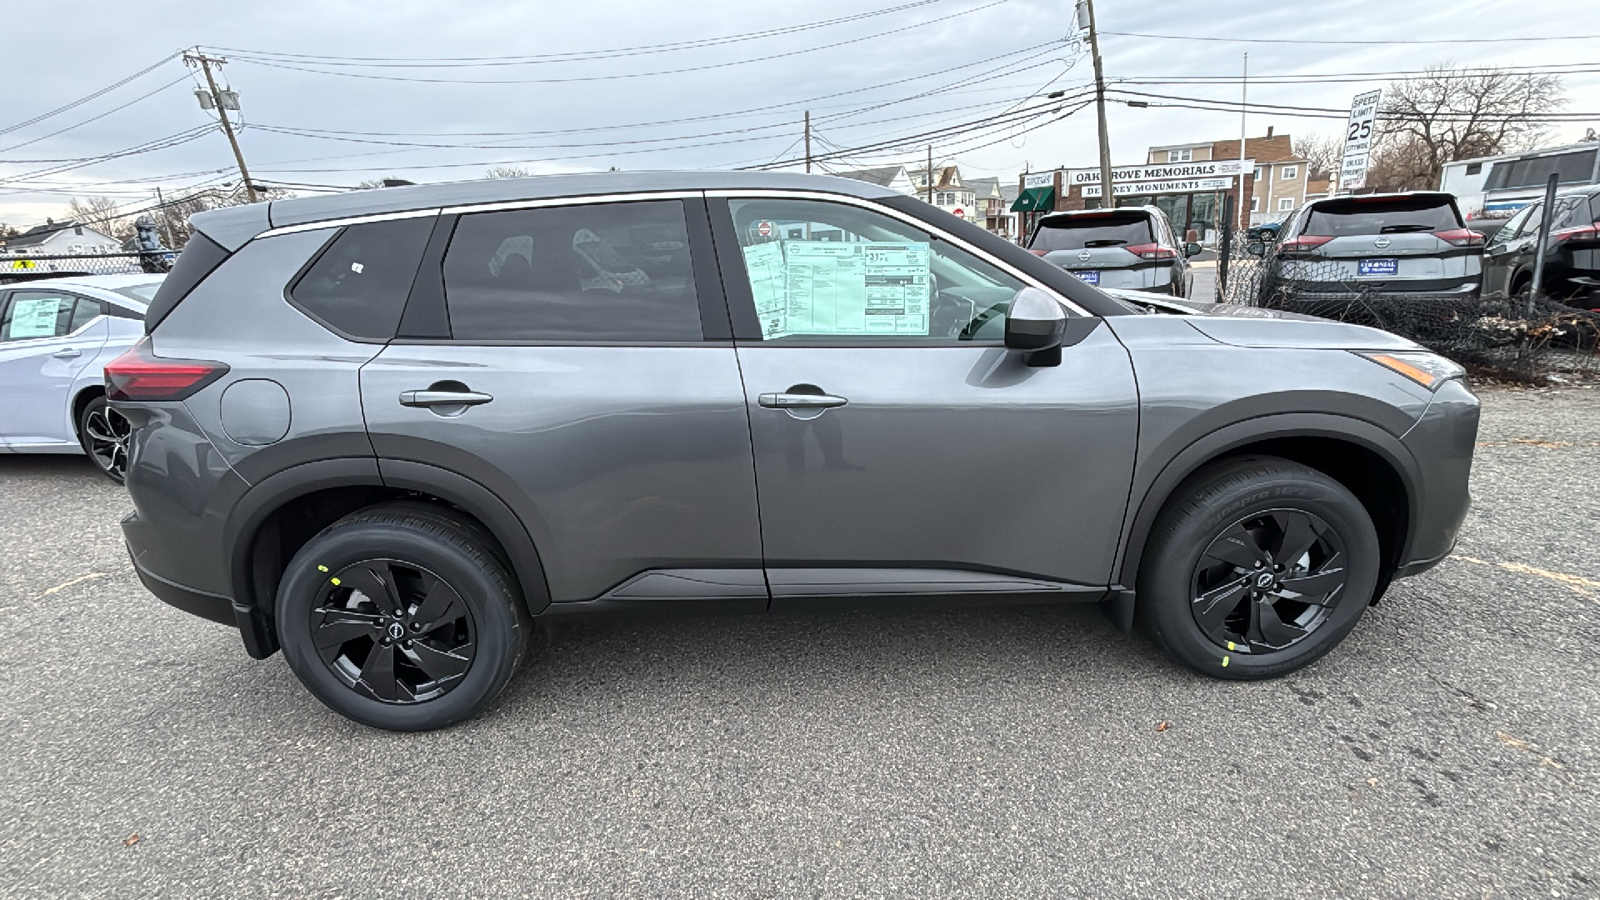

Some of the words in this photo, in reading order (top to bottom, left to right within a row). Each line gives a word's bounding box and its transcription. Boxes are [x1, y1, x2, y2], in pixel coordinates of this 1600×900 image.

[1353, 95, 1378, 108] SPEED
[1353, 107, 1373, 118] LIMIT
[1348, 119, 1372, 141] 25
[1346, 142, 1368, 152] CITYWIDE
[1346, 158, 1364, 168] UNLESS
[1076, 173, 1100, 183] OAK
[1111, 170, 1142, 180] ROVE
[1144, 165, 1216, 178] MEMORIALS
[1087, 185, 1132, 195] DENEY
[1135, 181, 1200, 192] MONUMENTS
